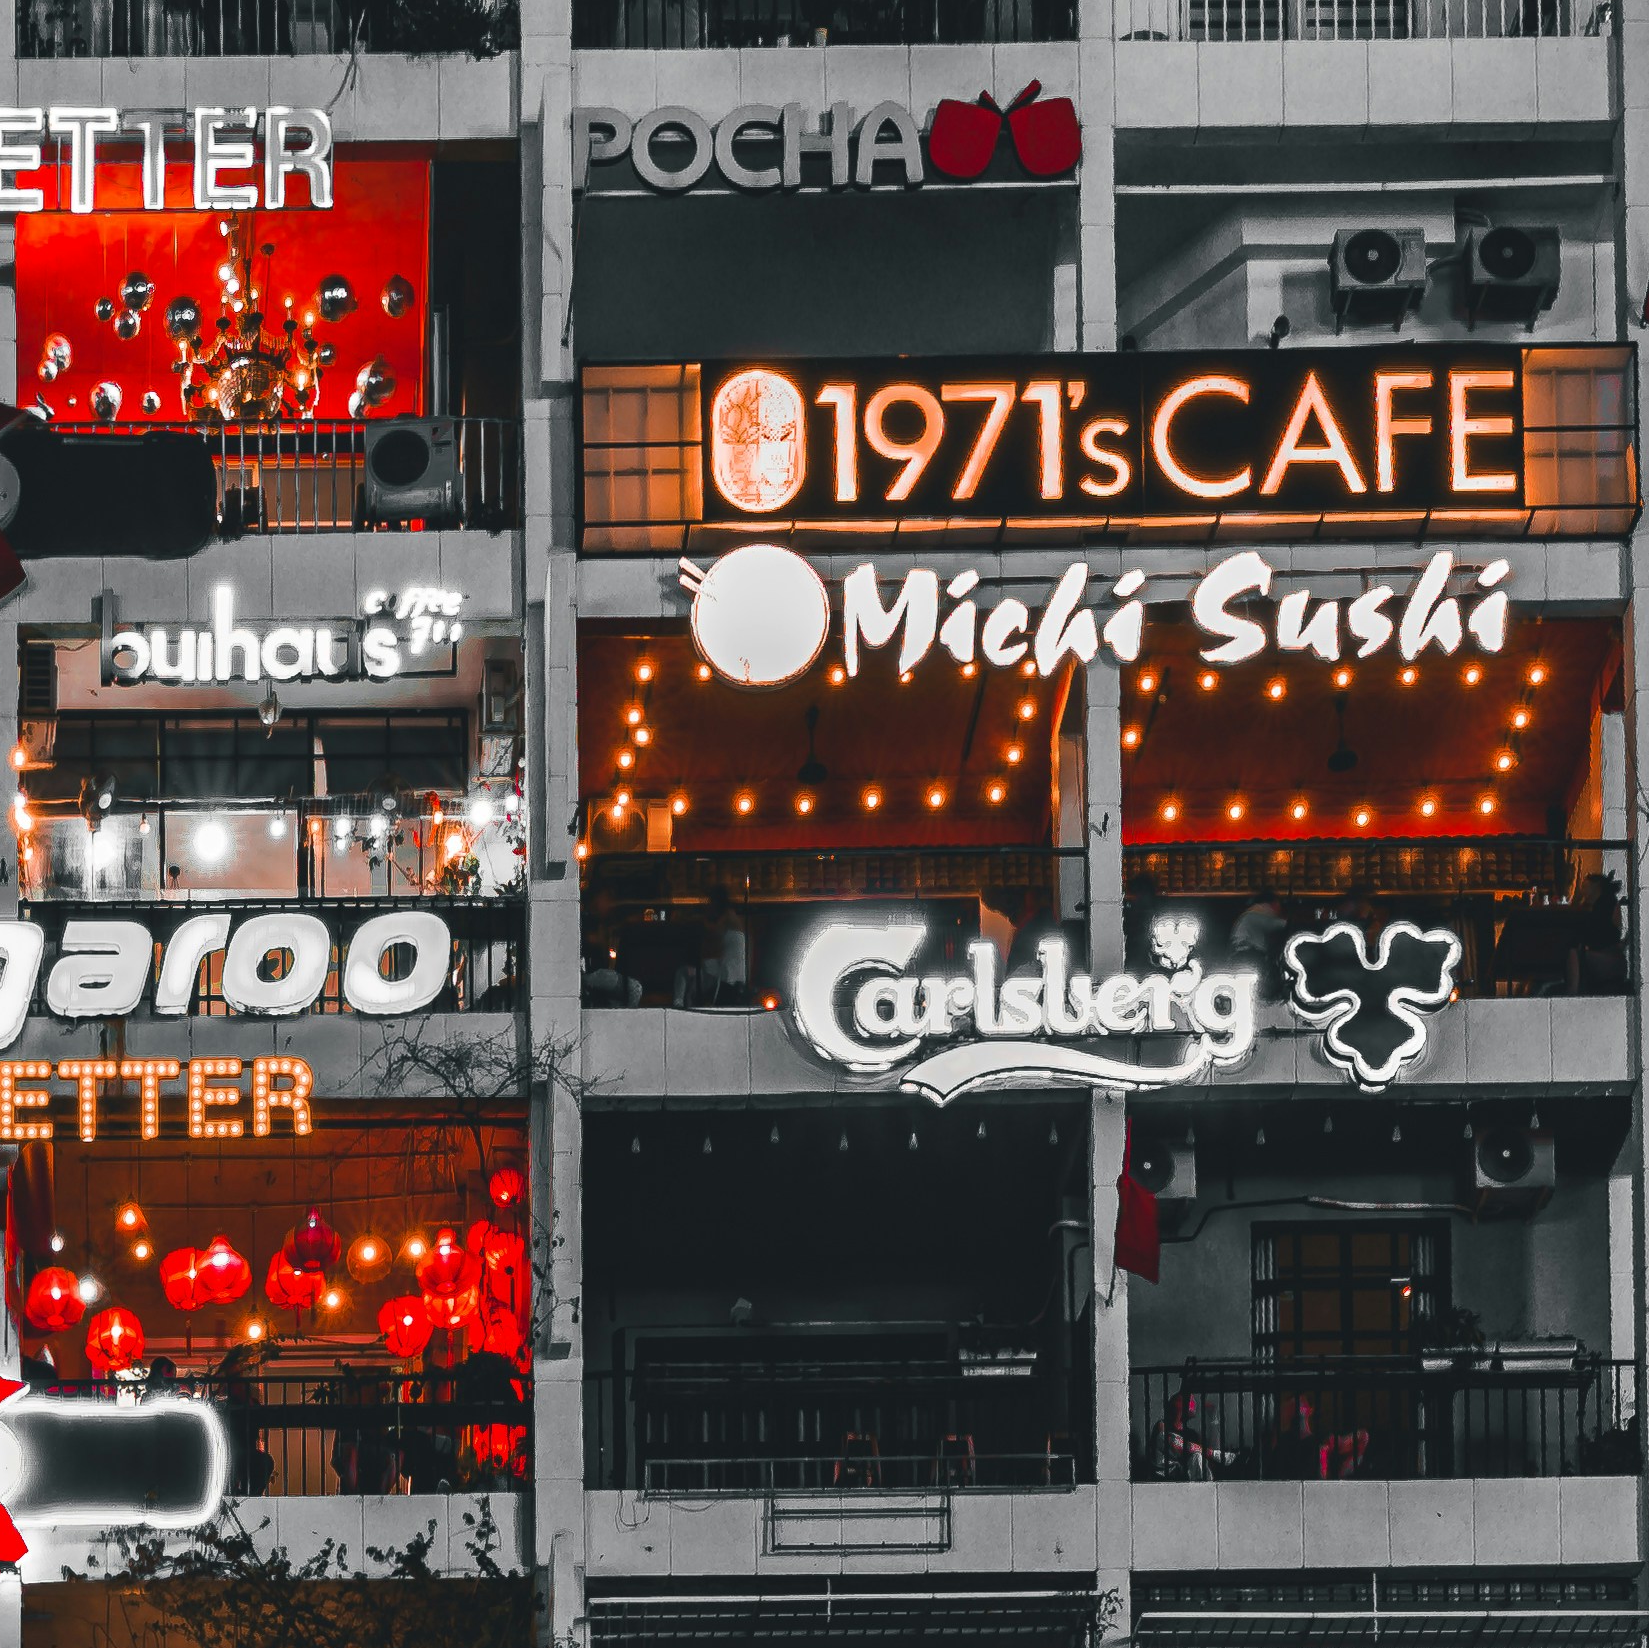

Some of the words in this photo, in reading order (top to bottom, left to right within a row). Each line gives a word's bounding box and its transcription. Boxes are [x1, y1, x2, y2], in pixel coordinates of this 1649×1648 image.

[573, 100, 926, 191] POCHA
[815, 377, 1132, 503] 1971's
[1152, 369, 1519, 503] CAFE
[842, 555, 1147, 678] Michi
[1191, 550, 1512, 666] Sushi
[793, 917, 1260, 1091] Carlsberg
